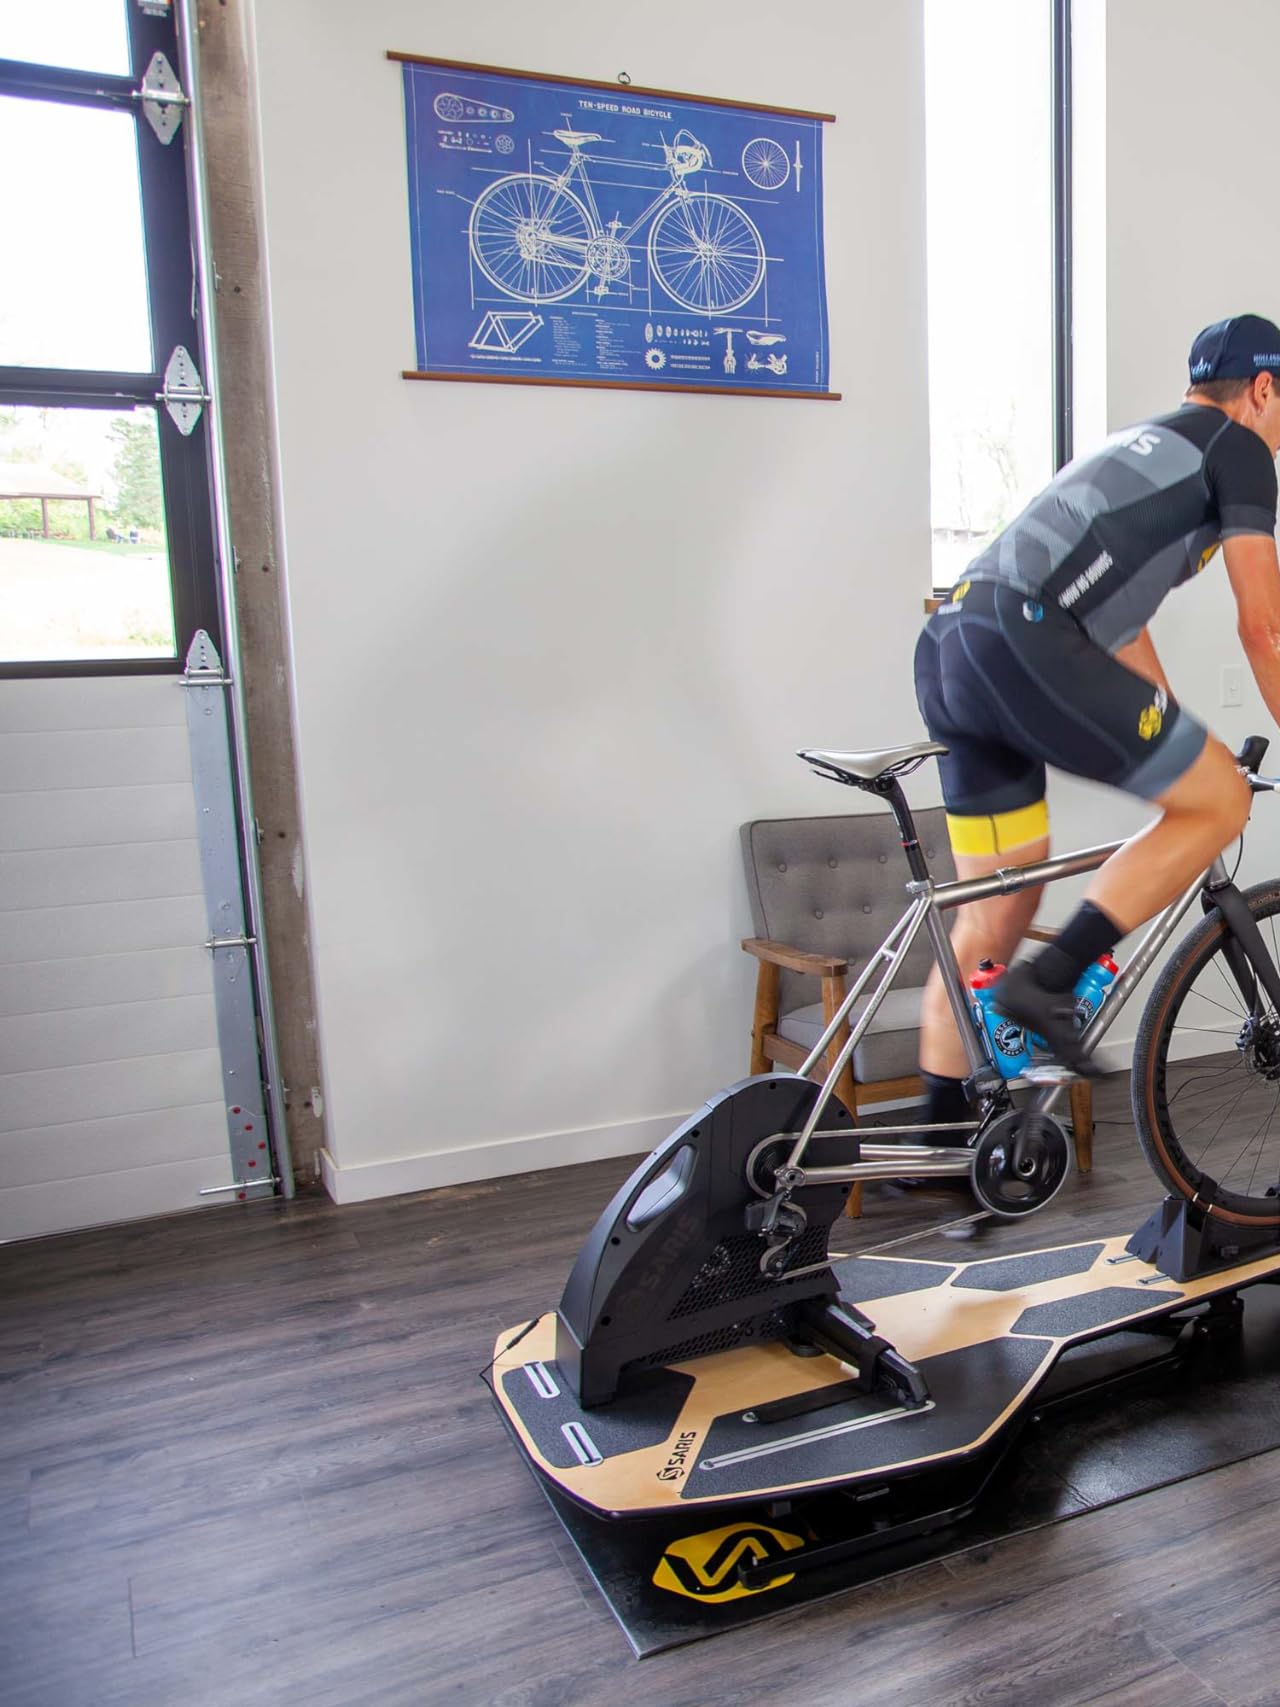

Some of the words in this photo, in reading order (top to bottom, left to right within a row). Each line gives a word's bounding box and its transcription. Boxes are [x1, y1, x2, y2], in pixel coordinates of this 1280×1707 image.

[578, 100, 619, 112] TEN-SPEED
[622, 106, 641, 115] ROAD
[643, 108, 673, 119] BICYCLE
[668, 1431, 697, 1465] SARIS
